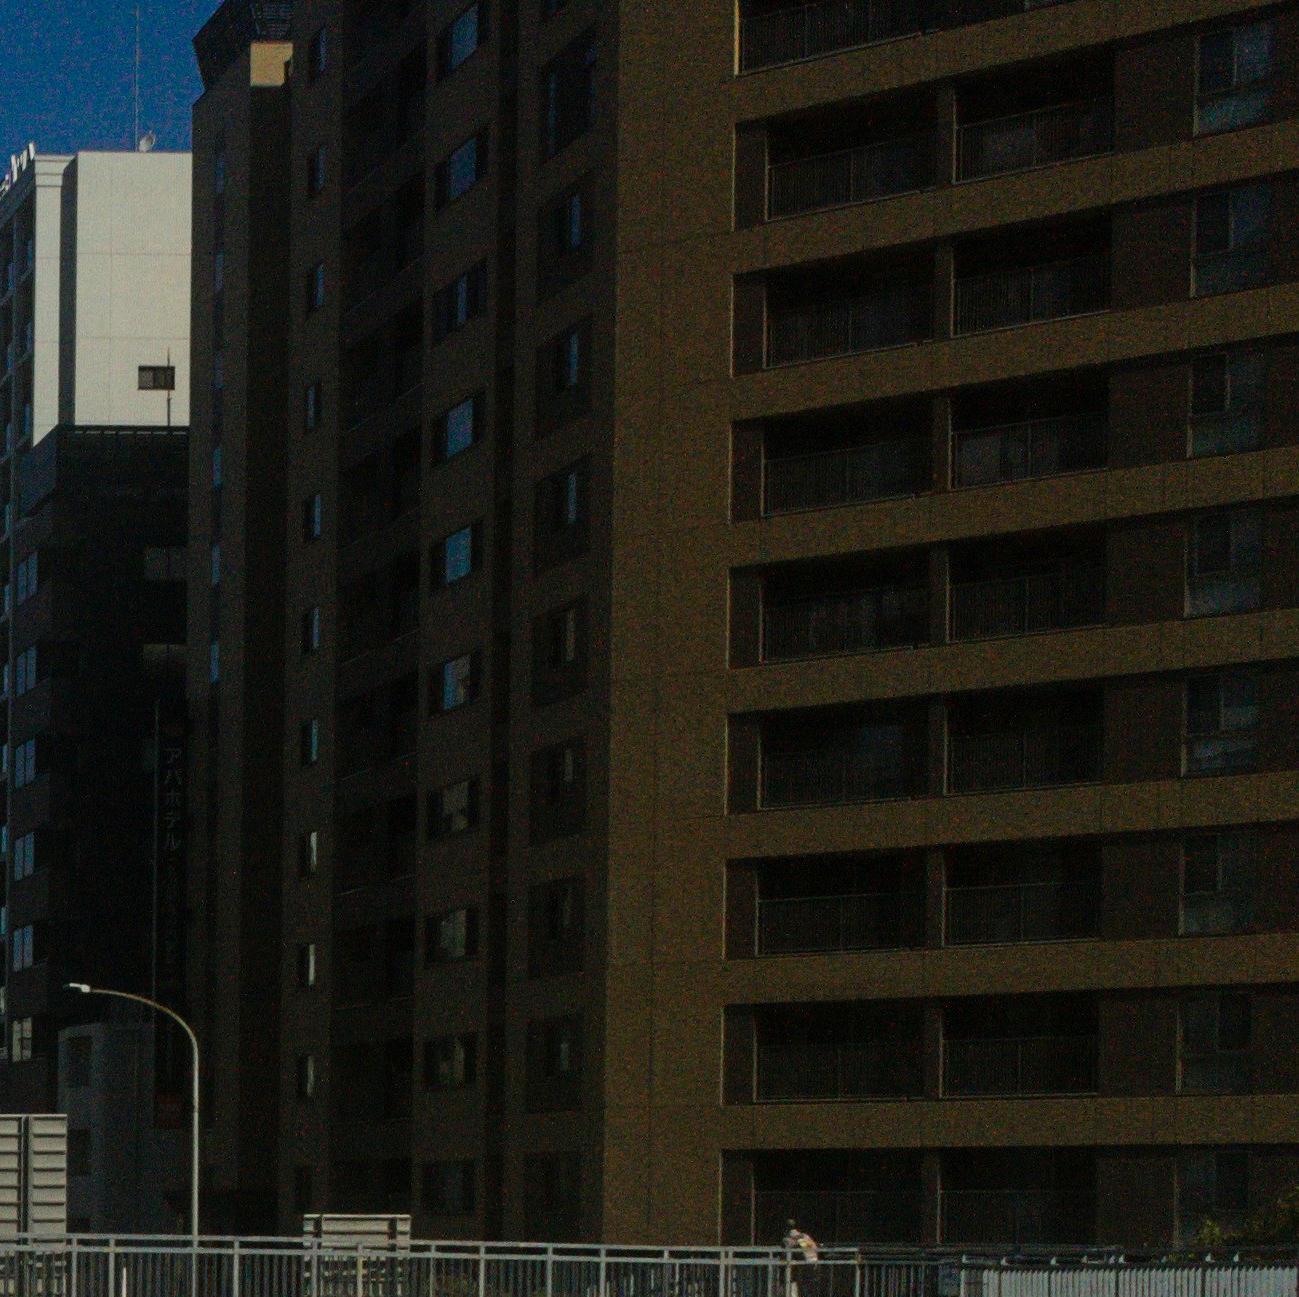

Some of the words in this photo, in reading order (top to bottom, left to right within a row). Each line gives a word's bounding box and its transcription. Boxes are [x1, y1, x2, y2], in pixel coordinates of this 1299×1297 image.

[163, 747, 182, 852] アパホテル
